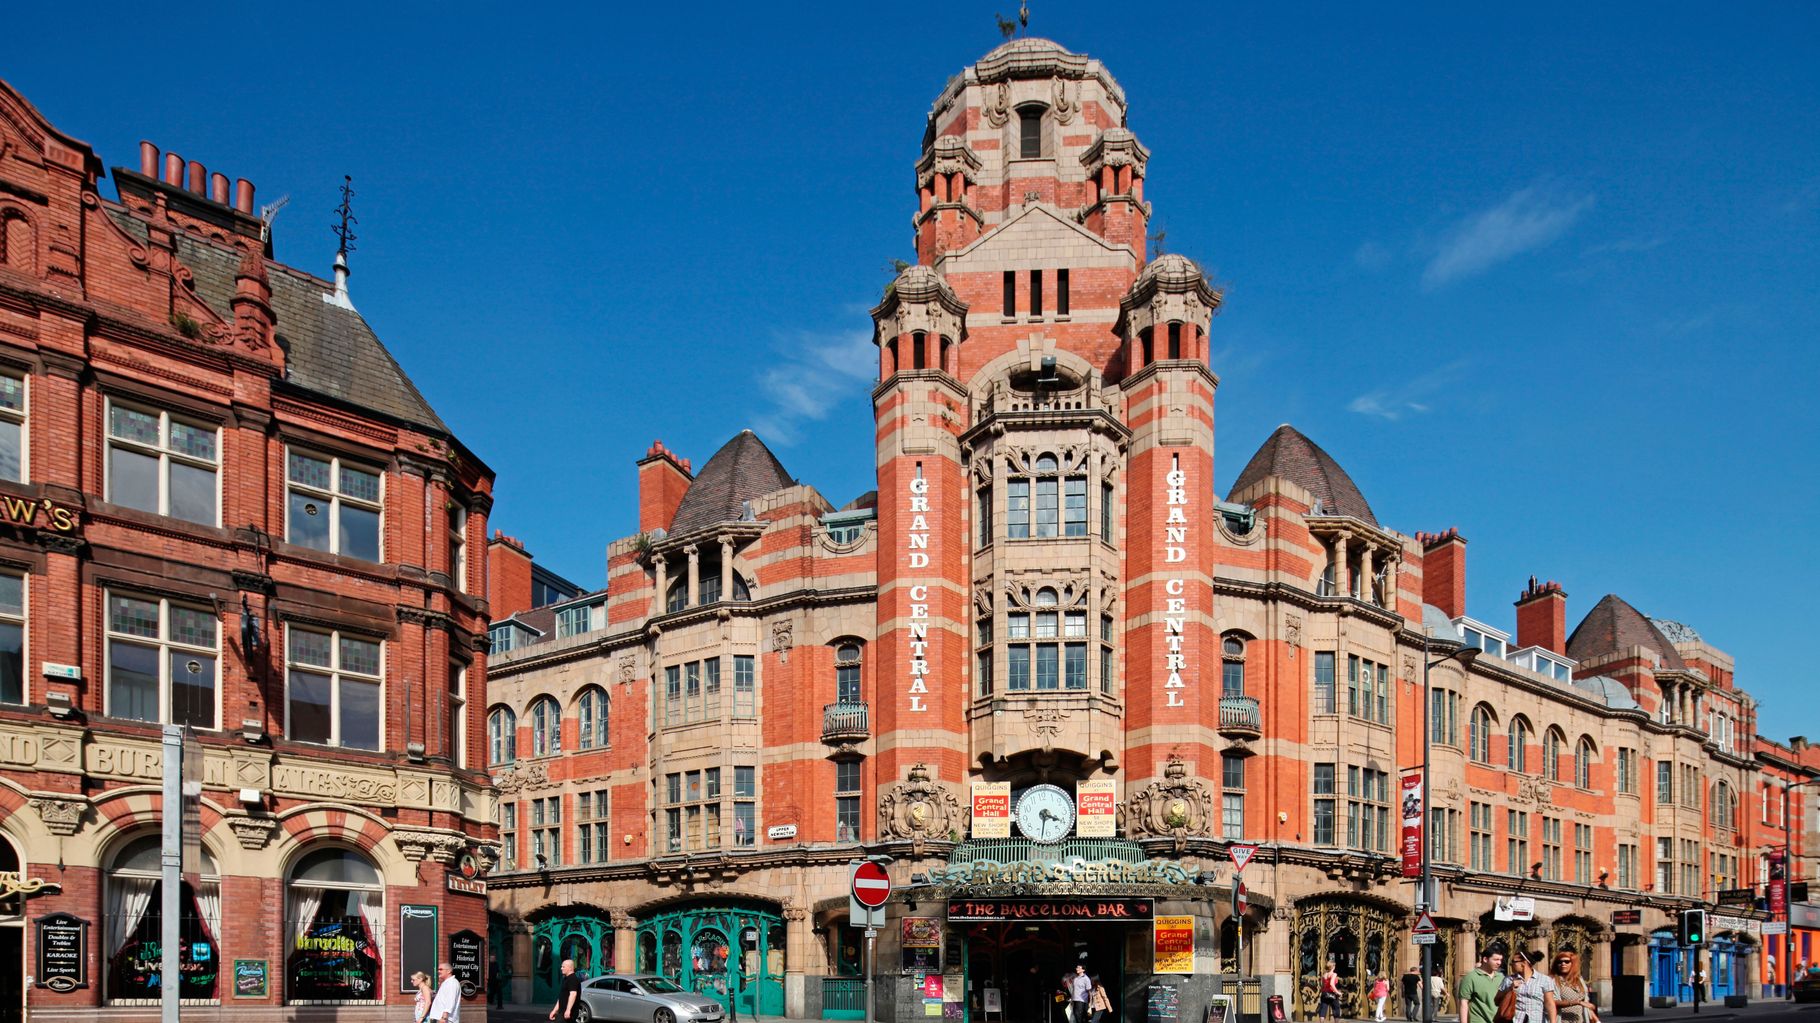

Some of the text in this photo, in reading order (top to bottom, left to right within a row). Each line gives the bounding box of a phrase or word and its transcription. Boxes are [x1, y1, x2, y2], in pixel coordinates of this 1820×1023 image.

[0, 496, 73, 531] W'S
[908, 478, 930, 712] GRAND CENTRAL
[1164, 470, 1187, 707] GRAND CENTRAL
[96, 748, 228, 786] BURN
[966, 902, 1131, 918] THE BARCELONA BAR
